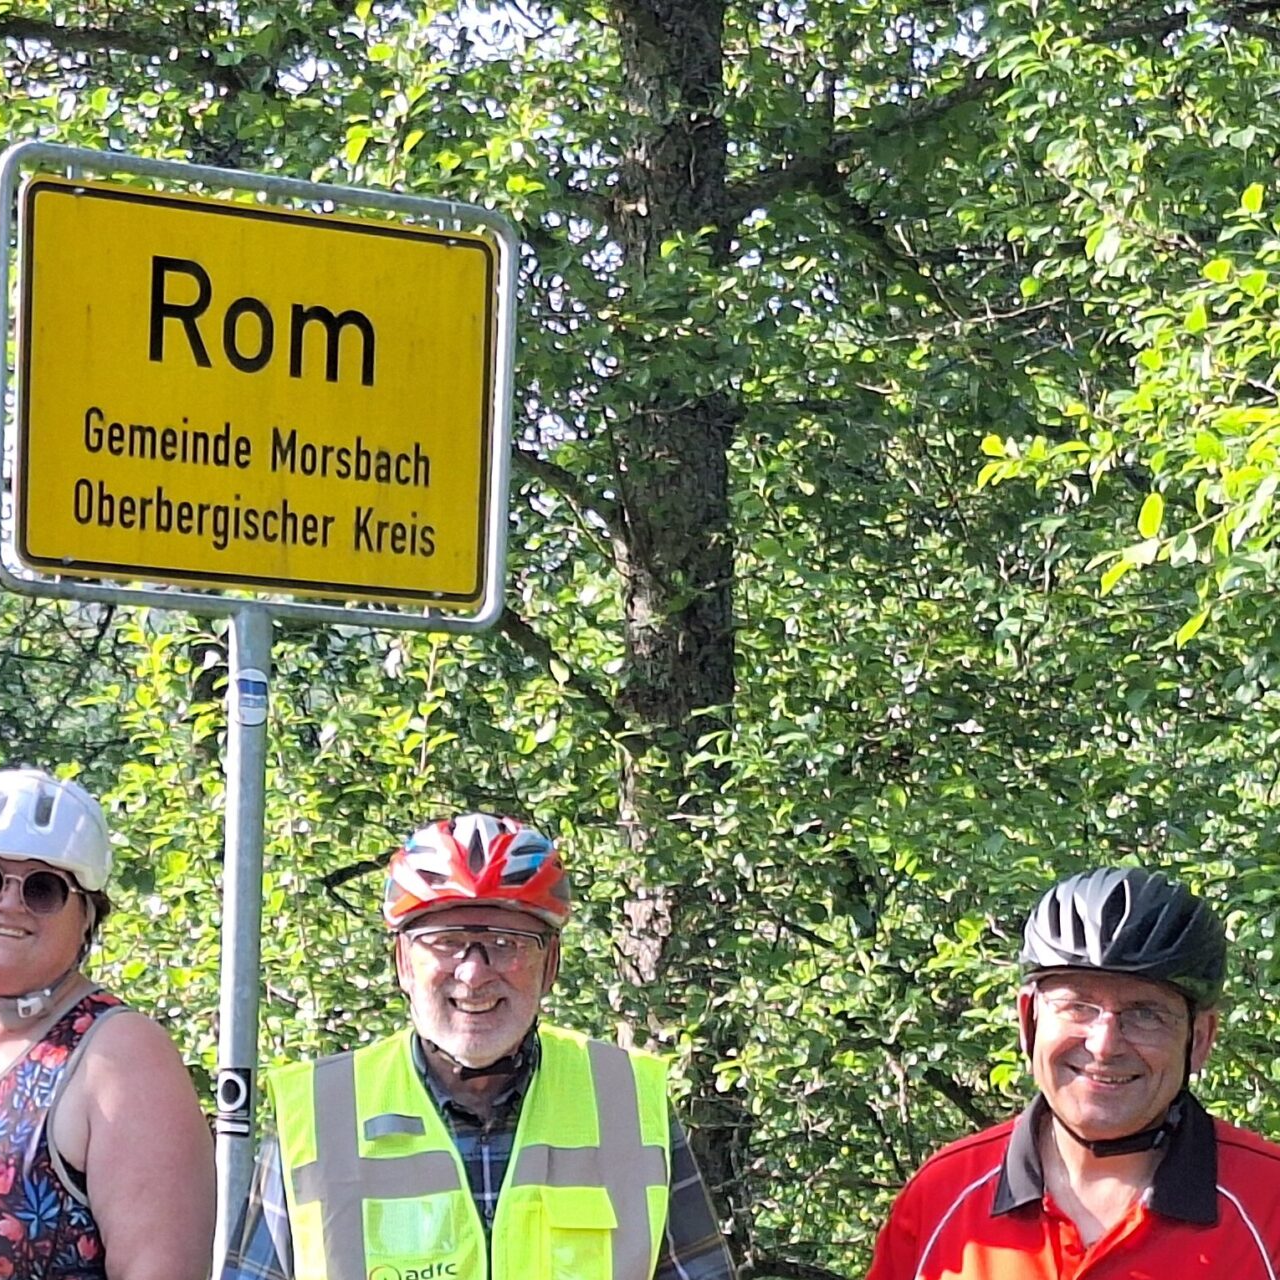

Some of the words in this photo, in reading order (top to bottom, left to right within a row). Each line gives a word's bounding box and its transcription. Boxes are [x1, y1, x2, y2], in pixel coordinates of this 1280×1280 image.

[149, 255, 376, 387] Rom
[84, 406, 252, 469] Gemeinde
[271, 427, 431, 488] Morsbach
[74, 478, 335, 550] Oberbergischer
[353, 506, 436, 558] Kreis
